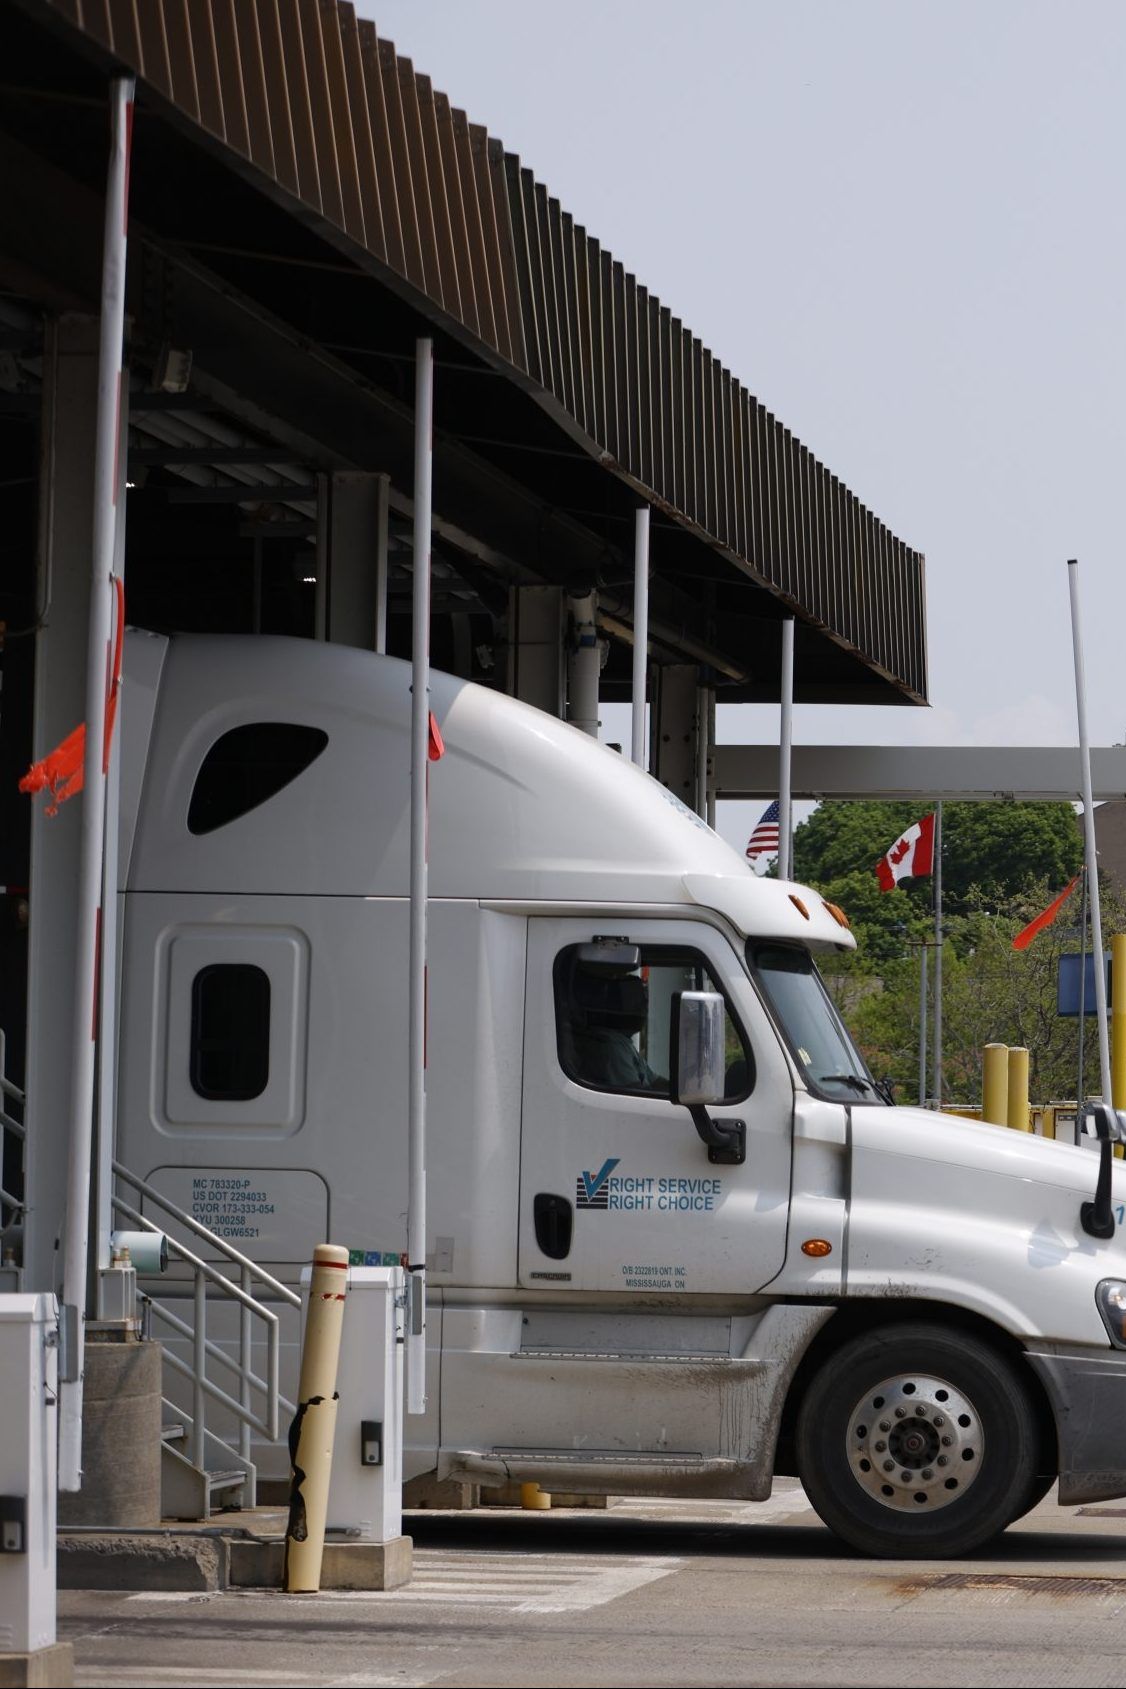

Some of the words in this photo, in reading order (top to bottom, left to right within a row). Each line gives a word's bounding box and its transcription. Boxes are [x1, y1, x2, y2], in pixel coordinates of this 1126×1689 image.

[193, 1179, 207, 1189] MC
[610, 1178, 655, 1193] RIGHT
[658, 1179, 721, 1194] SERVICE
[193, 1191, 206, 1200] US
[208, 1191, 228, 1201] DOT
[609, 1195, 654, 1209] RIGHT
[657, 1196, 714, 1210] CHOICE
[193, 1203, 219, 1213] CVOR
[626, 1279, 671, 1288] MISSISSAUGA
[675, 1280, 685, 1288] ON
